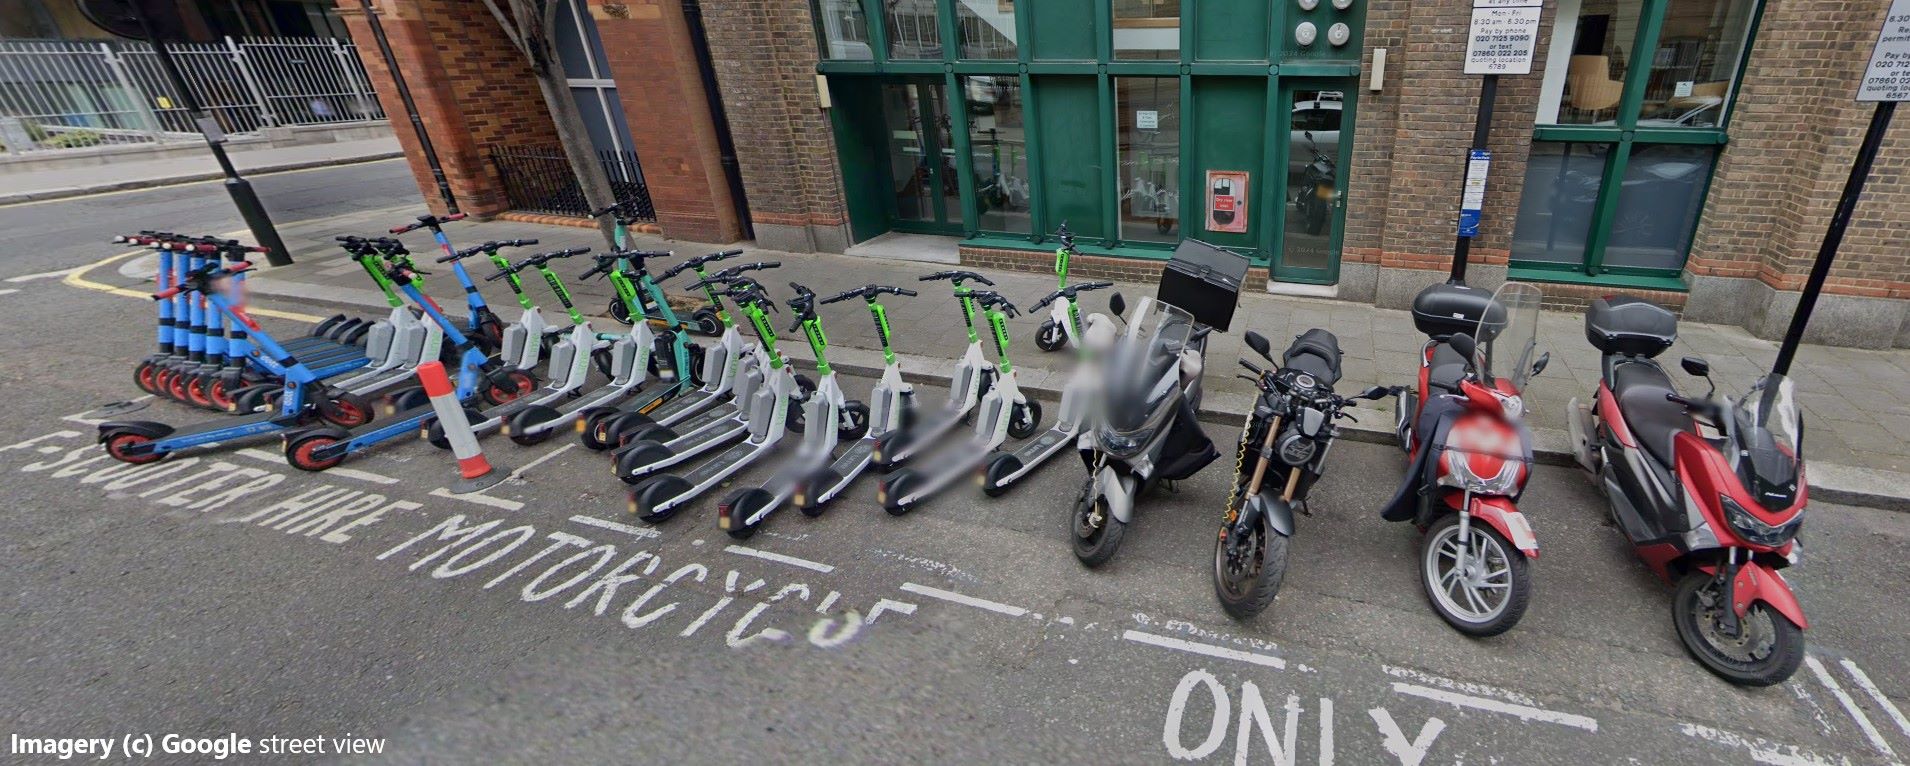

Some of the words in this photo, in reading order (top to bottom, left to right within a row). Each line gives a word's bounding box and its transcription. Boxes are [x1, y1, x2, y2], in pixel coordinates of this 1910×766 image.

[1884, 52, 1900, 60] Pay
[1866, 84, 1899, 92] quoting
[232, 485, 424, 544] HIRE
